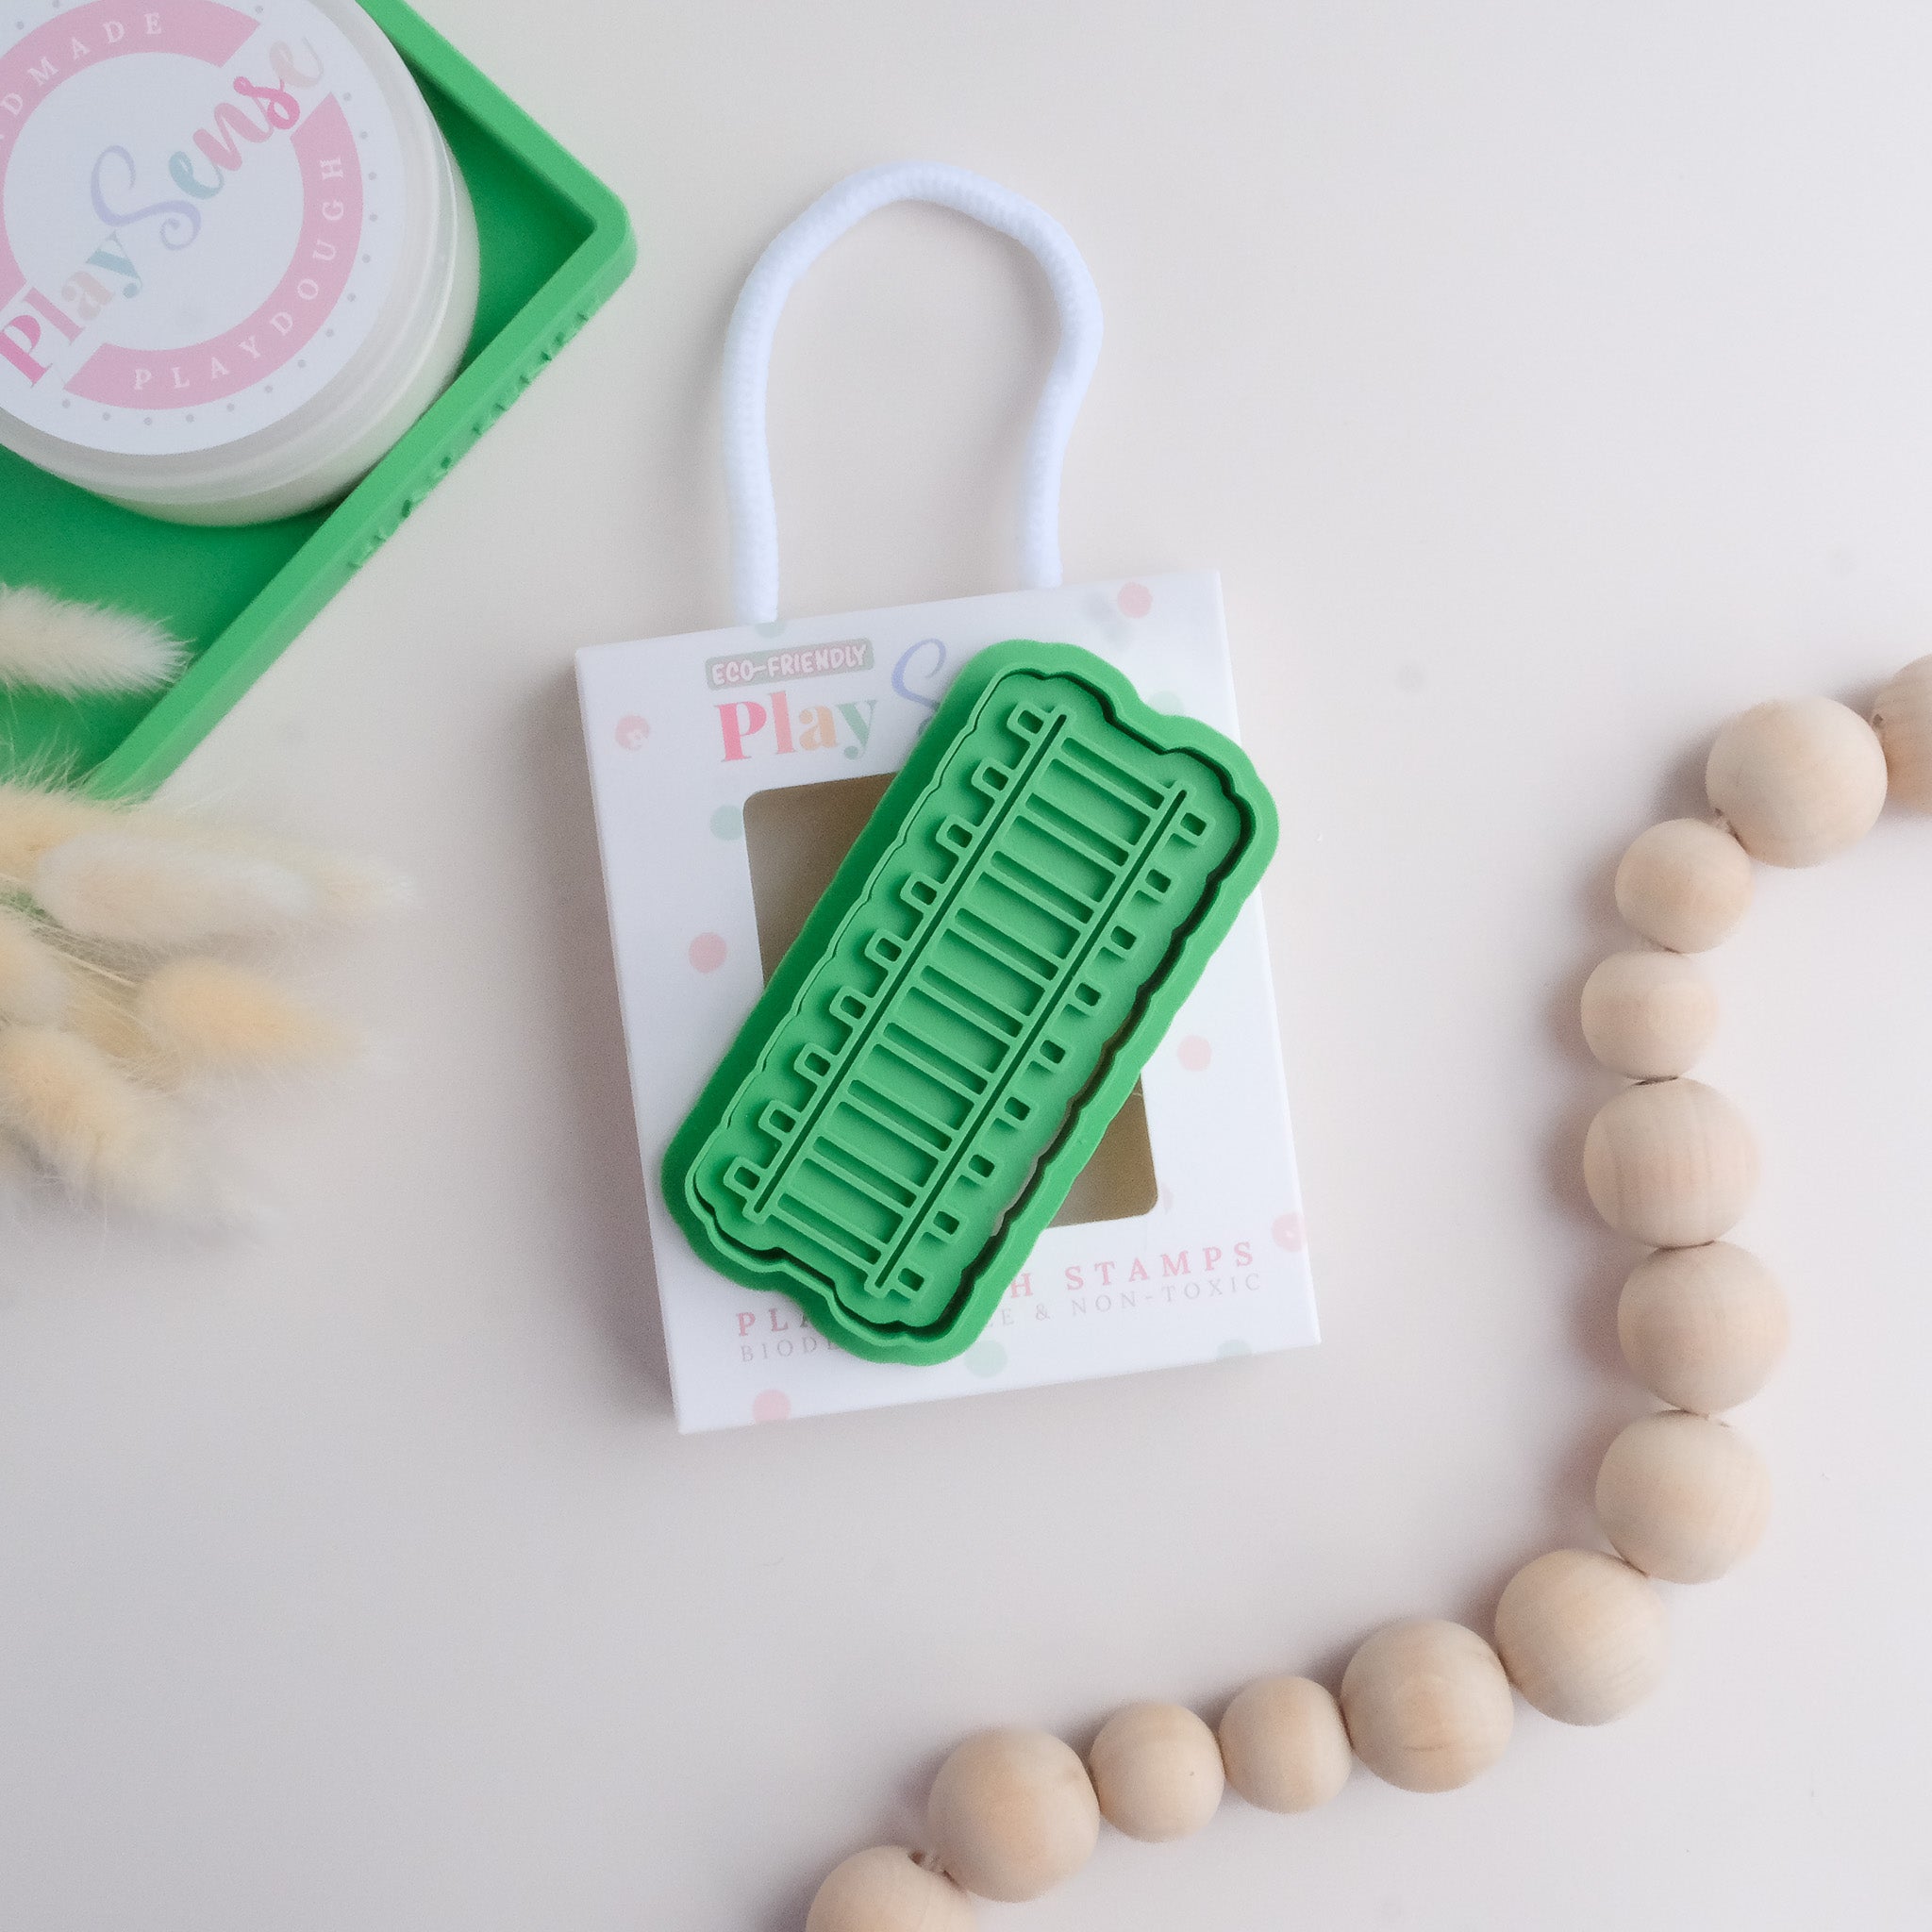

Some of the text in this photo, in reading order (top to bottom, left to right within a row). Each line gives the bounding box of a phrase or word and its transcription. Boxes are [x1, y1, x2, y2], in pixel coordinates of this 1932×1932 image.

[0, 10, 163, 142] DMADE
[0, 35, 325, 388] Play Sense
[133, 156, 346, 391] PLAYDOUGH
[711, 643, 867, 686] ECO-FRIENDLY
[713, 690, 878, 763] Play
[1035, 1303, 1051, 1322] &
[1071, 1272, 1261, 1317] NON-TOXIC
[1063, 1241, 1254, 1291] STAMPS
